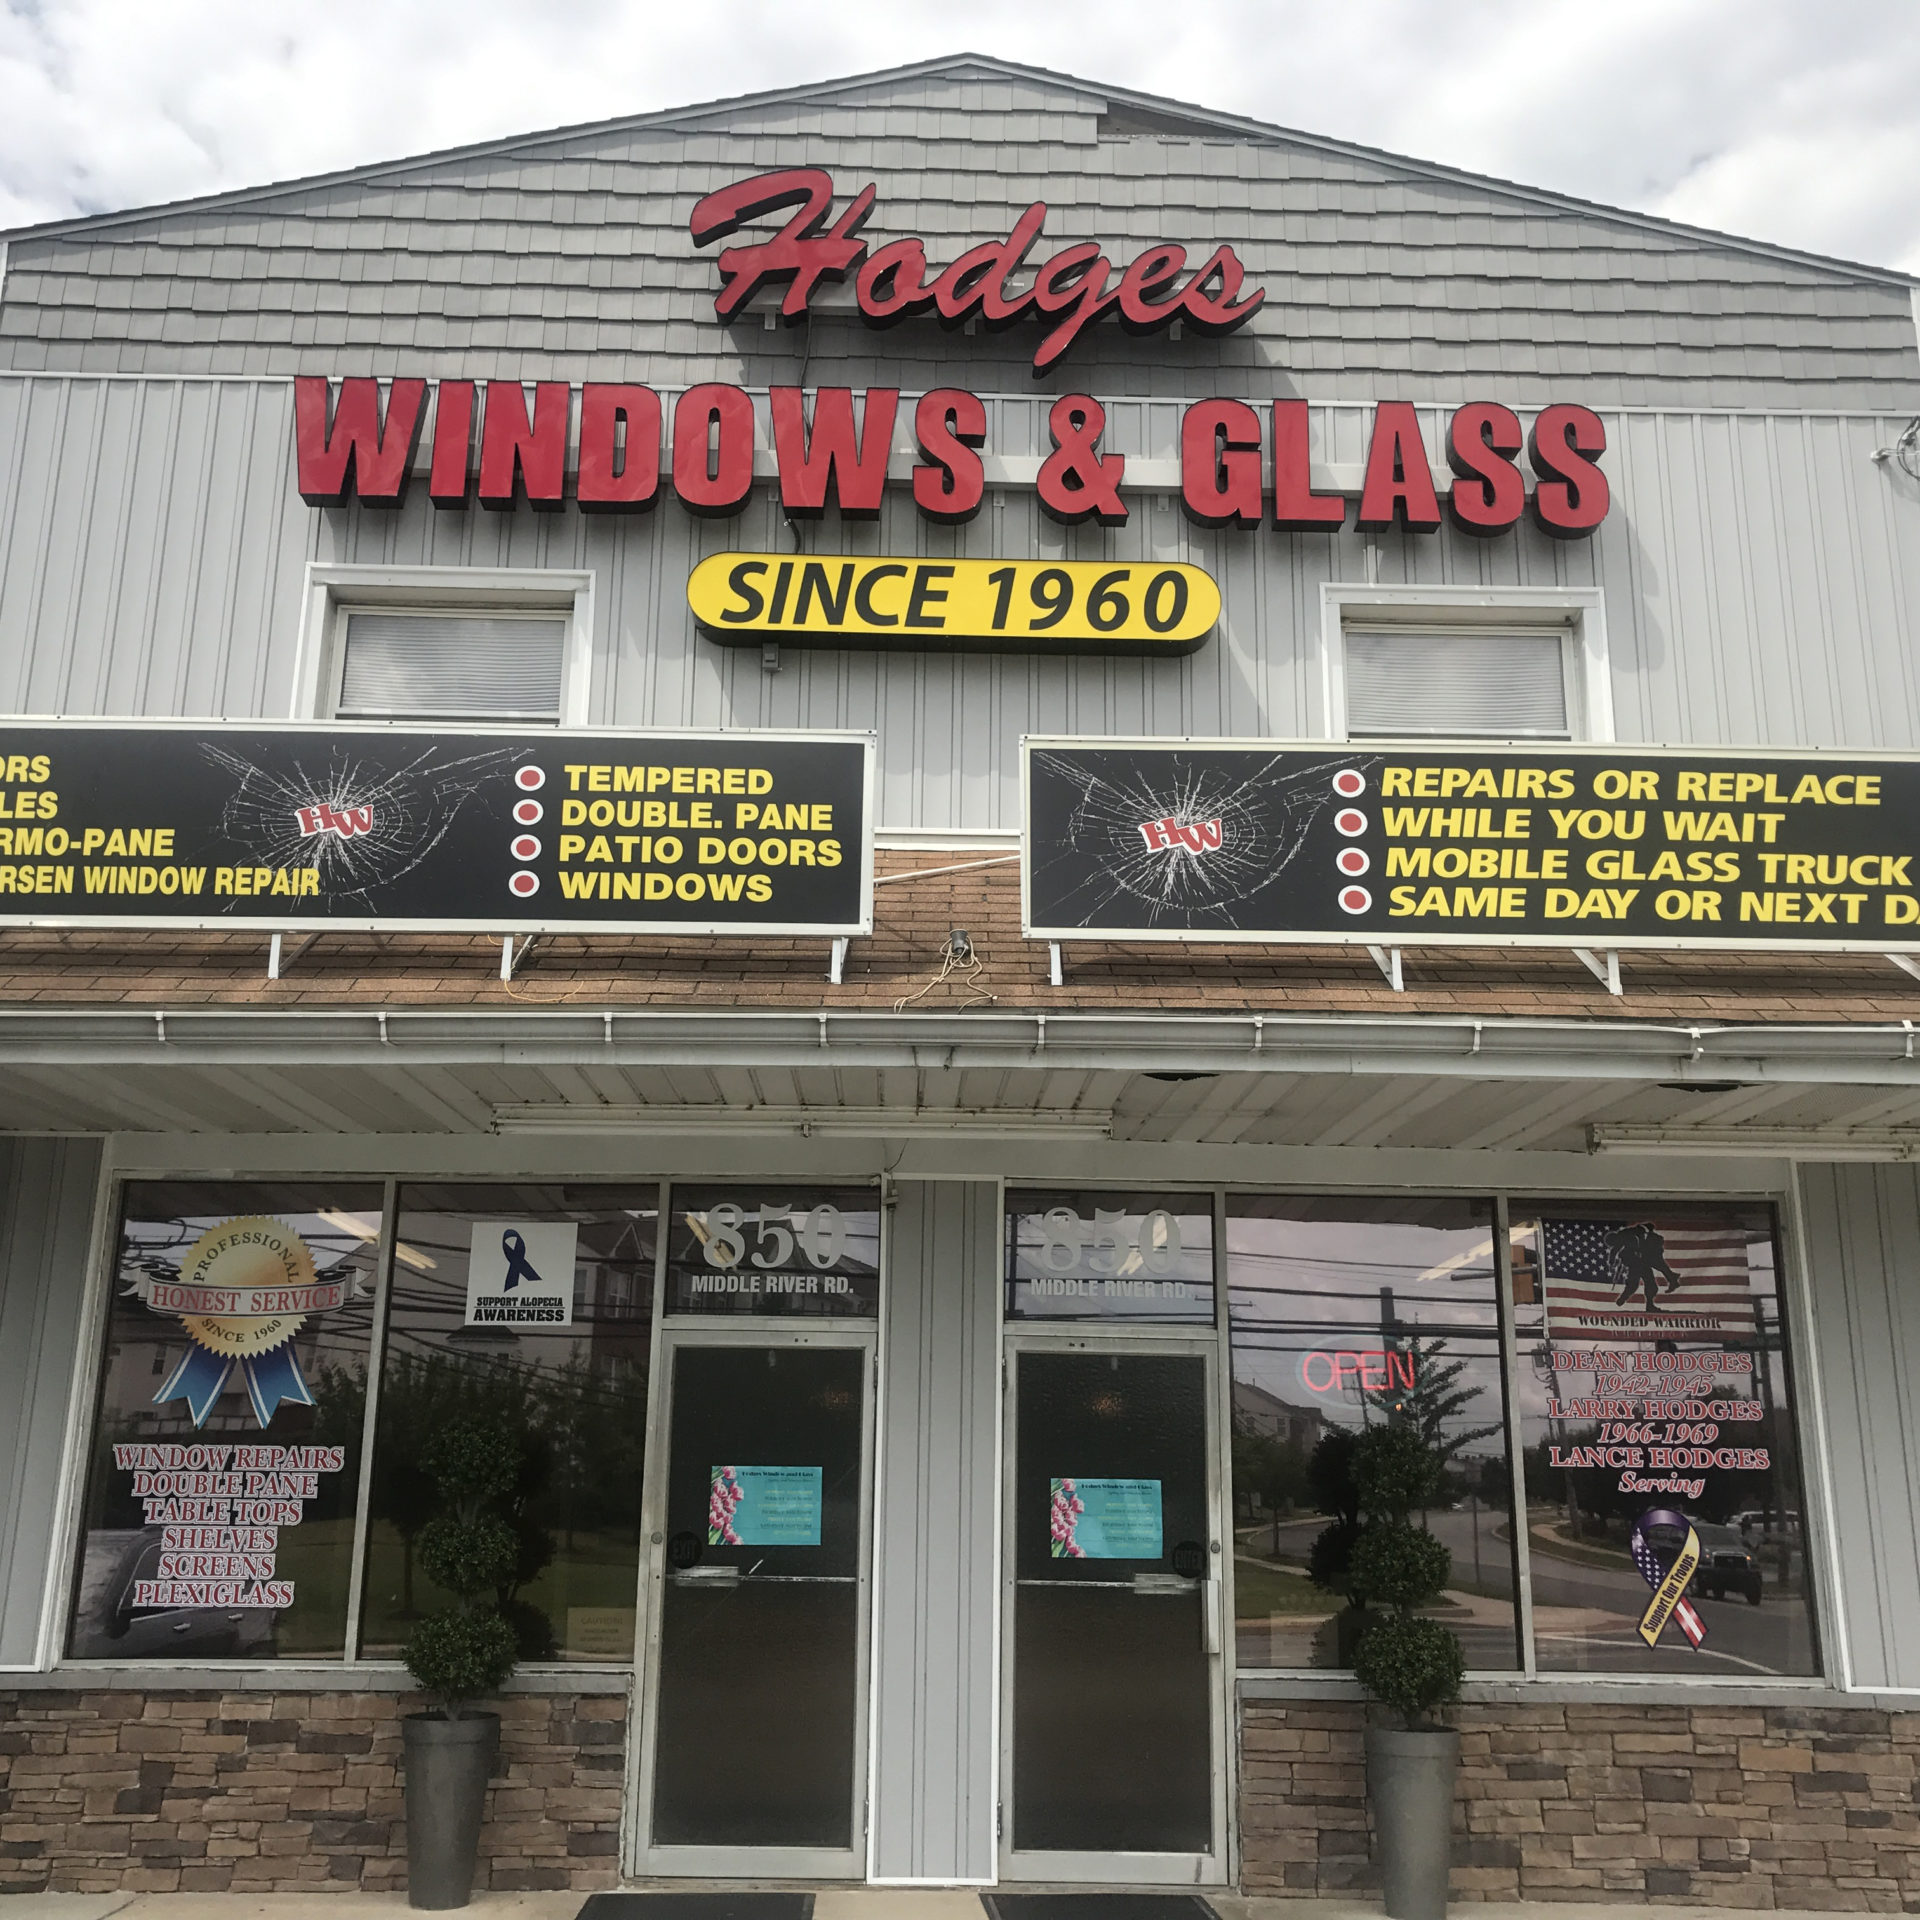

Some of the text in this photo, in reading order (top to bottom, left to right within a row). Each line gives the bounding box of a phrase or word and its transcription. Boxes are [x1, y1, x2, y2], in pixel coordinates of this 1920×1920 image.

[690, 167, 1265, 374] Hodges
[294, 374, 1611, 532] WINDOWS & GLASS
[720, 561, 1189, 632] SINCE 1960
[564, 765, 774, 795] TEMPERED
[1381, 767, 1882, 805] REPAIRS OR REPLACE
[296, 802, 375, 840] HW
[561, 799, 833, 831] DOUBLE. PANE
[1382, 807, 1786, 843] WHILE YOU WAIT
[559, 835, 843, 867] PATIO DOORS
[1139, 817, 1223, 856] HW
[0, 865, 320, 896] RSEN WINDOW REPAIR
[1385, 847, 1913, 886] MOBILE GLASS TRUCK
[558, 872, 773, 902] WINDOWS
[1388, 886, 1920, 925] SAME DAY OR NEXT D
[703, 1203, 847, 1269] 850
[1041, 1207, 1182, 1274] 850
[193, 1232, 299, 1283] PROFESSIONAL
[151, 1285, 341, 1312] HONEST SERVICE
[691, 1275, 854, 1294] MIDDLE RIVER RD.
[1031, 1278, 1099, 1297] MIDDLE
[1104, 1280, 1156, 1298] RIVER
[473, 1308, 565, 1322] AWARENESS
[477, 1297, 563, 1307] SUPPORT ALOPECIA
[201, 1318, 283, 1343] SINCE 1960
[1578, 1316, 1721, 1330] WOUNDED WARRIOR
[1303, 1349, 1415, 1392] OPEN
[1551, 1351, 1753, 1374] DEAN HODGES
[1593, 1374, 1714, 1396] 1942-1945
[1549, 1399, 1764, 1421] LARRY HODGES
[1597, 1422, 1719, 1445] 1966-1969
[114, 1445, 344, 1471] WINDOW REPAIRS
[1549, 1447, 1770, 1470] LANCE HODGES
[132, 1472, 318, 1498] DOUBLE PANE
[1618, 1471, 1705, 1499] Serving
[144, 1498, 302, 1525] TABLE TOPS
[161, 1526, 278, 1551] SHELVES
[158, 1554, 276, 1579] SCREENS
[133, 1580, 295, 1607] PLEXIGLASS
[1643, 1553, 1696, 1634] Support Our Troops
